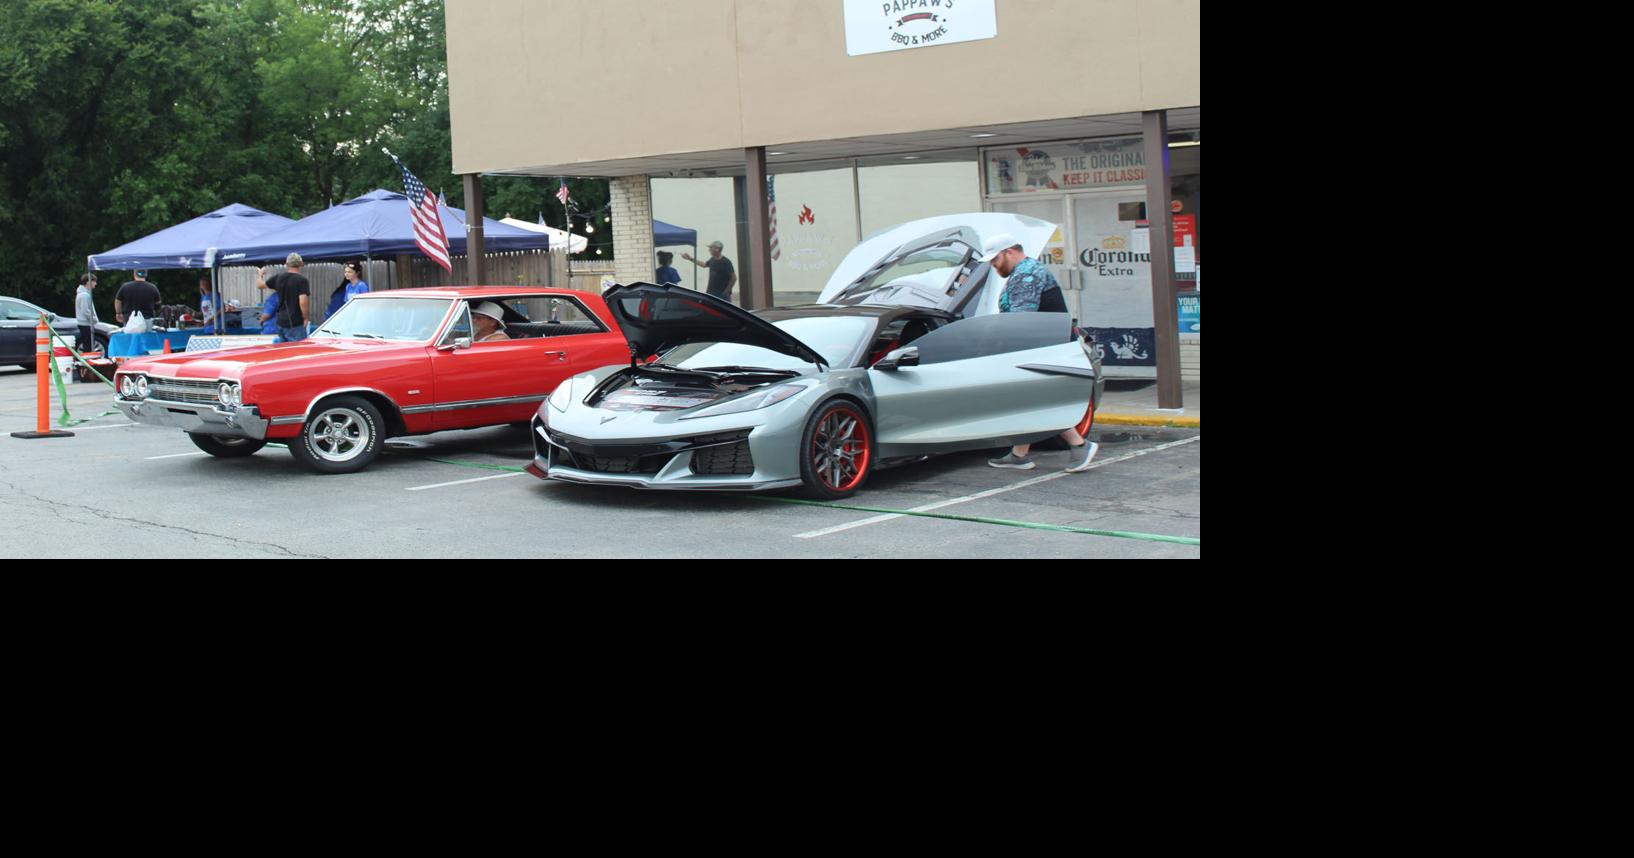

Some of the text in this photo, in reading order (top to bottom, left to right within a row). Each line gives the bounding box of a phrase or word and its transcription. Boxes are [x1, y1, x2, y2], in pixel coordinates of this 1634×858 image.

[883, 0, 953, 16] PAPPAWS
[890, 25, 948, 45] BBQ & MORE
[1062, 156, 1087, 171] THE
[1063, 168, 1147, 186] KEEP IT CLASSI
[1099, 265, 1134, 276] Extra
[1178, 297, 1199, 306] YOUR
